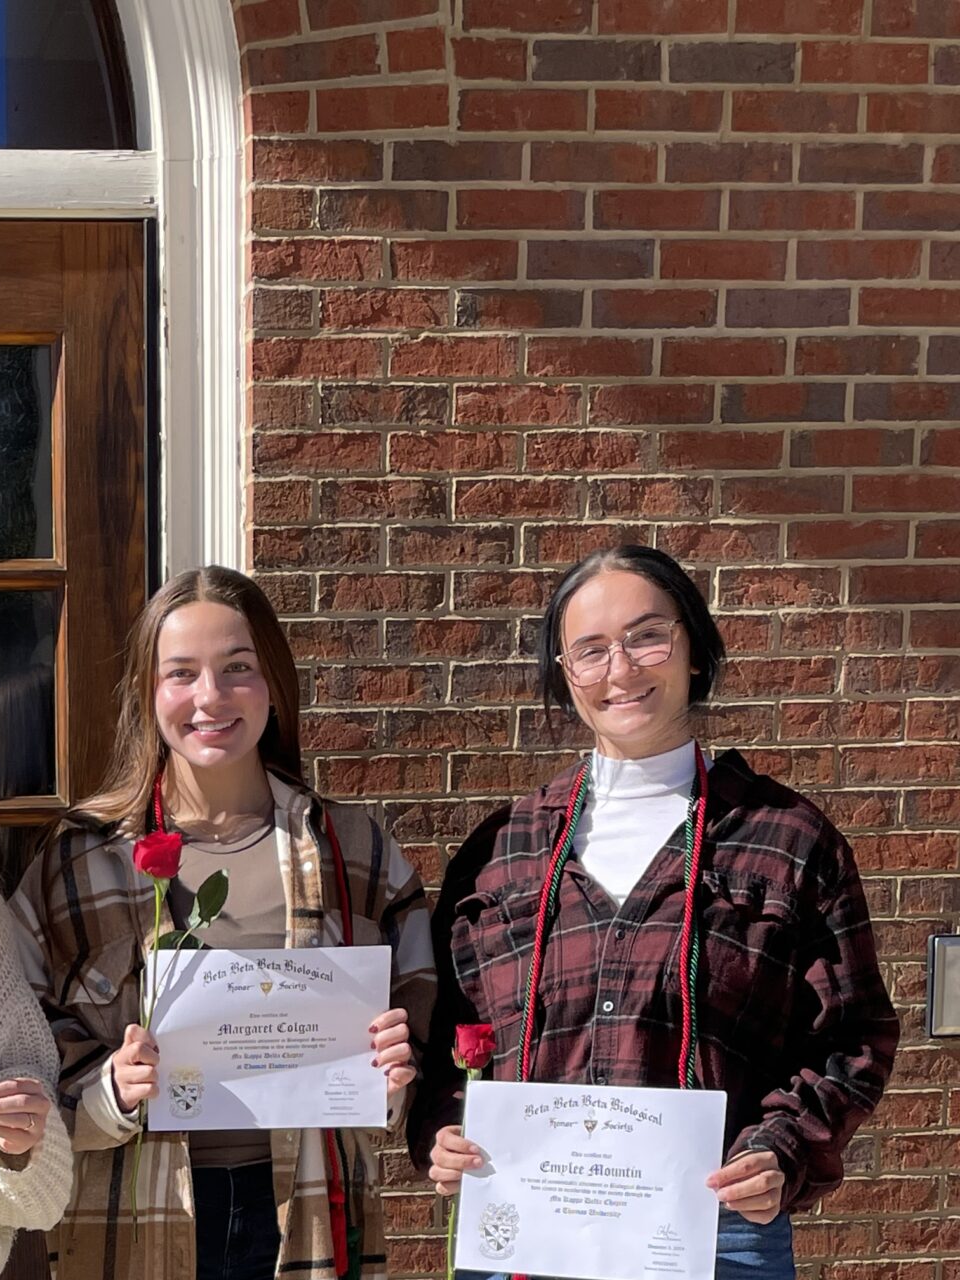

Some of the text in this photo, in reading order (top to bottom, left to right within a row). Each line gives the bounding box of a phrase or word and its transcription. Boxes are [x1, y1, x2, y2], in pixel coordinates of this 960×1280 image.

[203, 958, 333, 986] Beta Beta Beta Biological
[227, 981, 307, 992] Honor Society
[218, 1022, 319, 1036] Margaret Colgan
[524, 1095, 662, 1126] Beta Beta Beta Biological
[549, 1118, 633, 1132] Honor Society
[540, 1161, 642, 1178] Emylee Mountin
